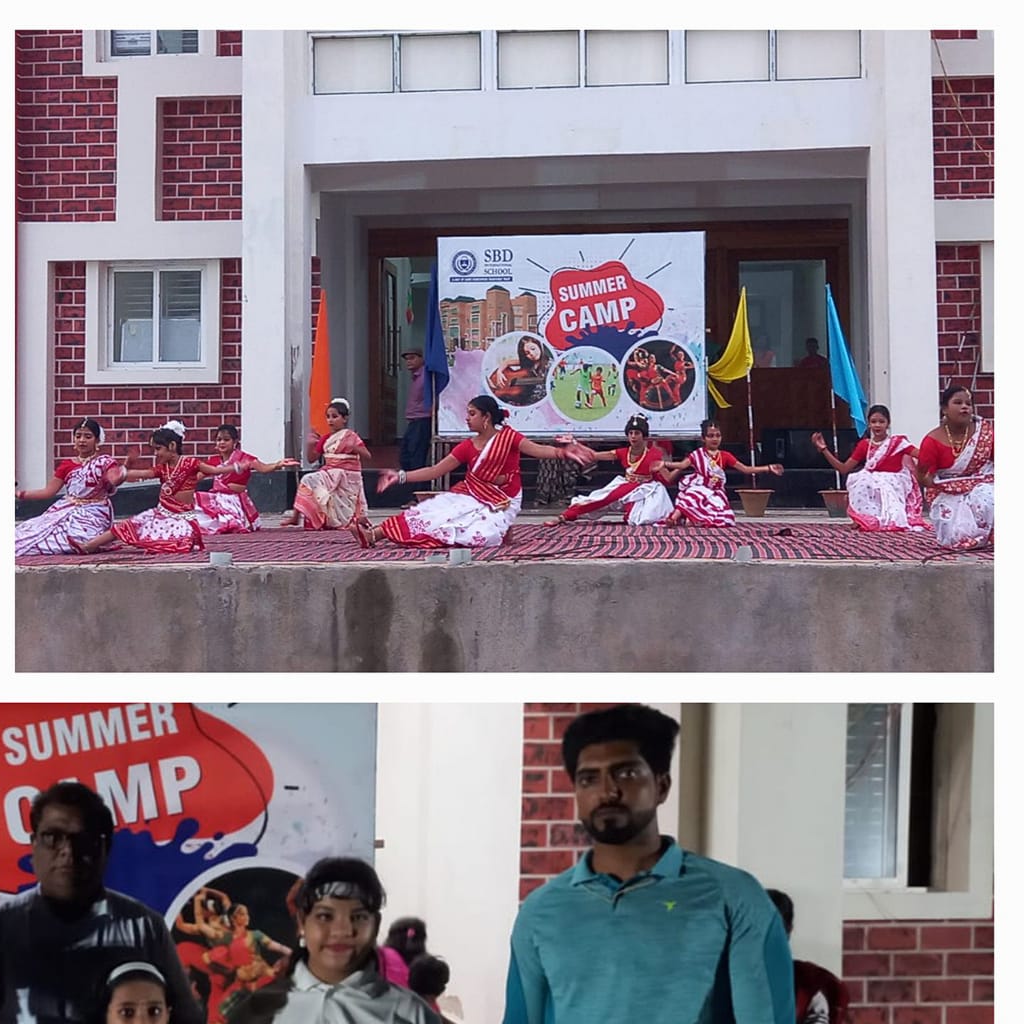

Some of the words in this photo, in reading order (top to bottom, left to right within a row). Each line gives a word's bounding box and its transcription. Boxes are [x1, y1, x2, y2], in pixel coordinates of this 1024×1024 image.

[484, 249, 513, 262] SBD
[558, 275, 627, 302] SUMMER
[559, 297, 636, 332] CAMP
[2, 703, 179, 766] SUMMER
[4, 755, 201, 845] CMP
